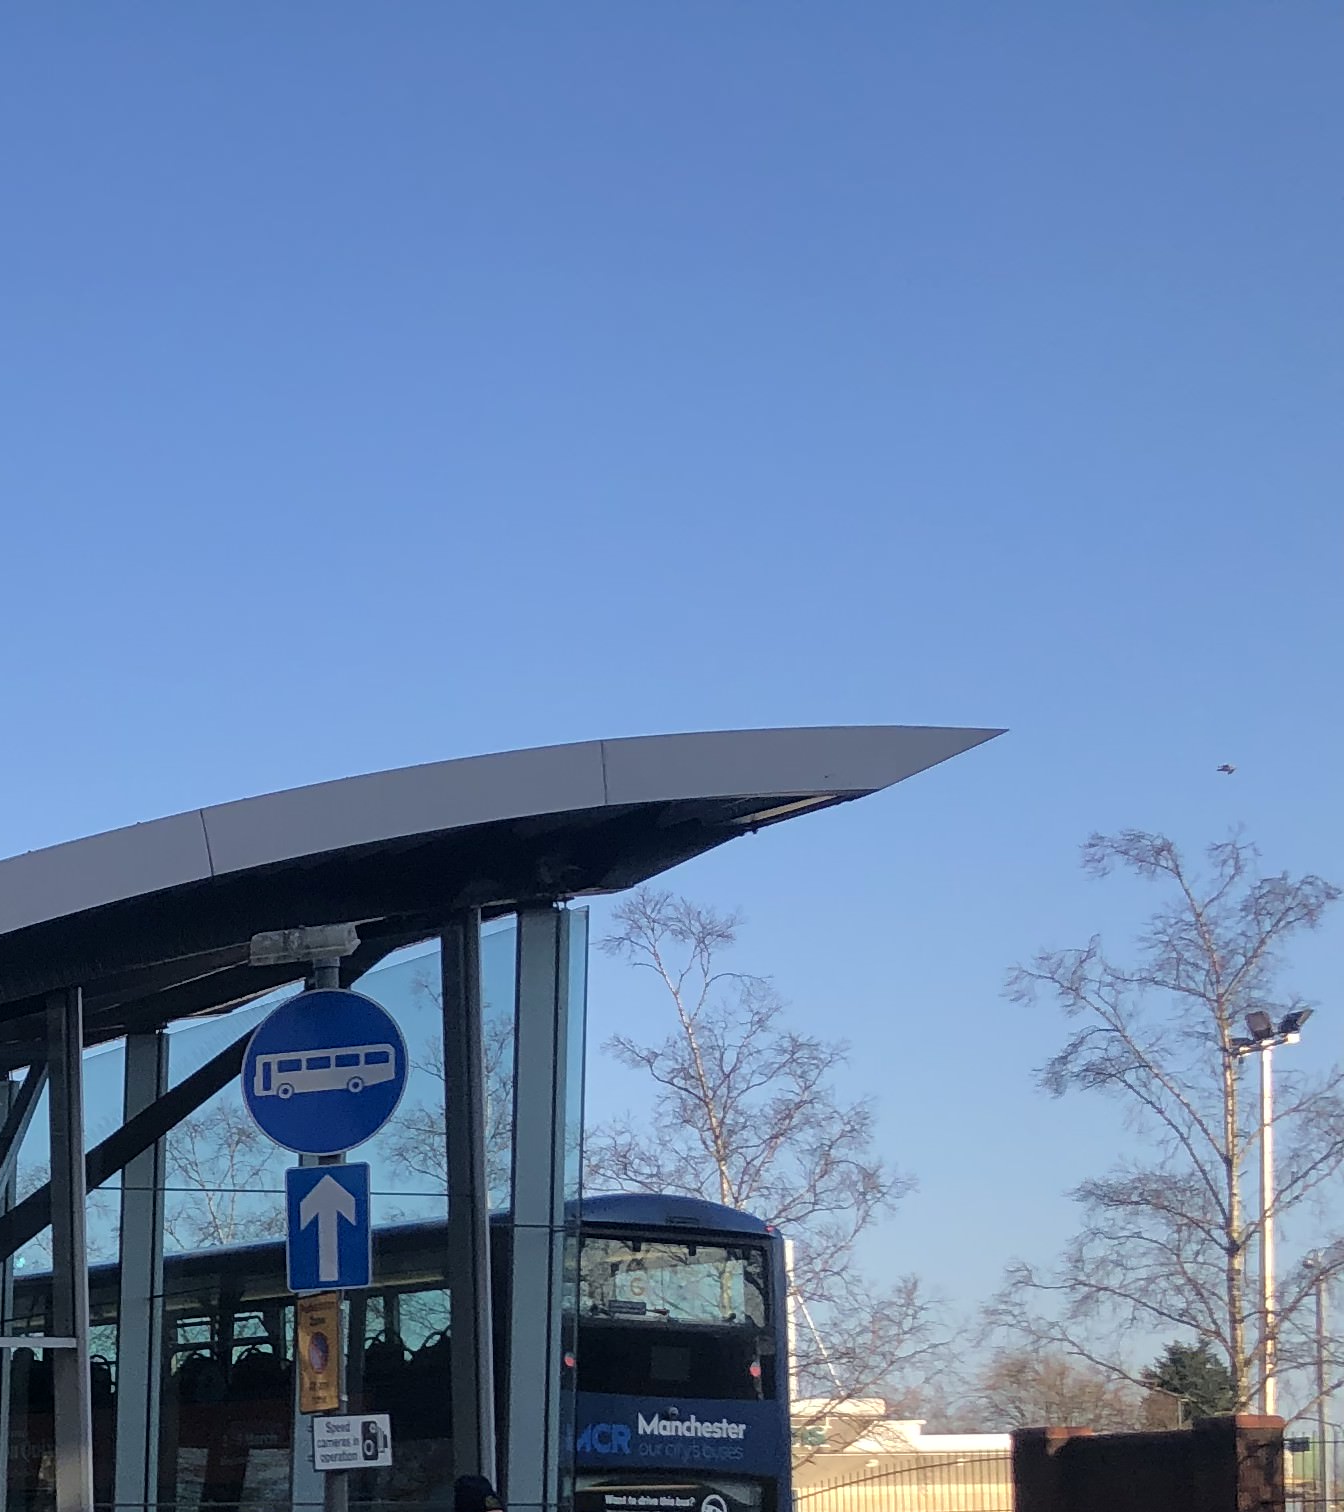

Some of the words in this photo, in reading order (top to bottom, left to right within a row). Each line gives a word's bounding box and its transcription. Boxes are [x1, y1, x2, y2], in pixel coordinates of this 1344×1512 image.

[325, 1420, 351, 1434] Speed
[638, 1412, 747, 1440] Manchester
[317, 1437, 351, 1449] cameras
[319, 1450, 359, 1464] operation
[702, 1442, 745, 1460] buses
